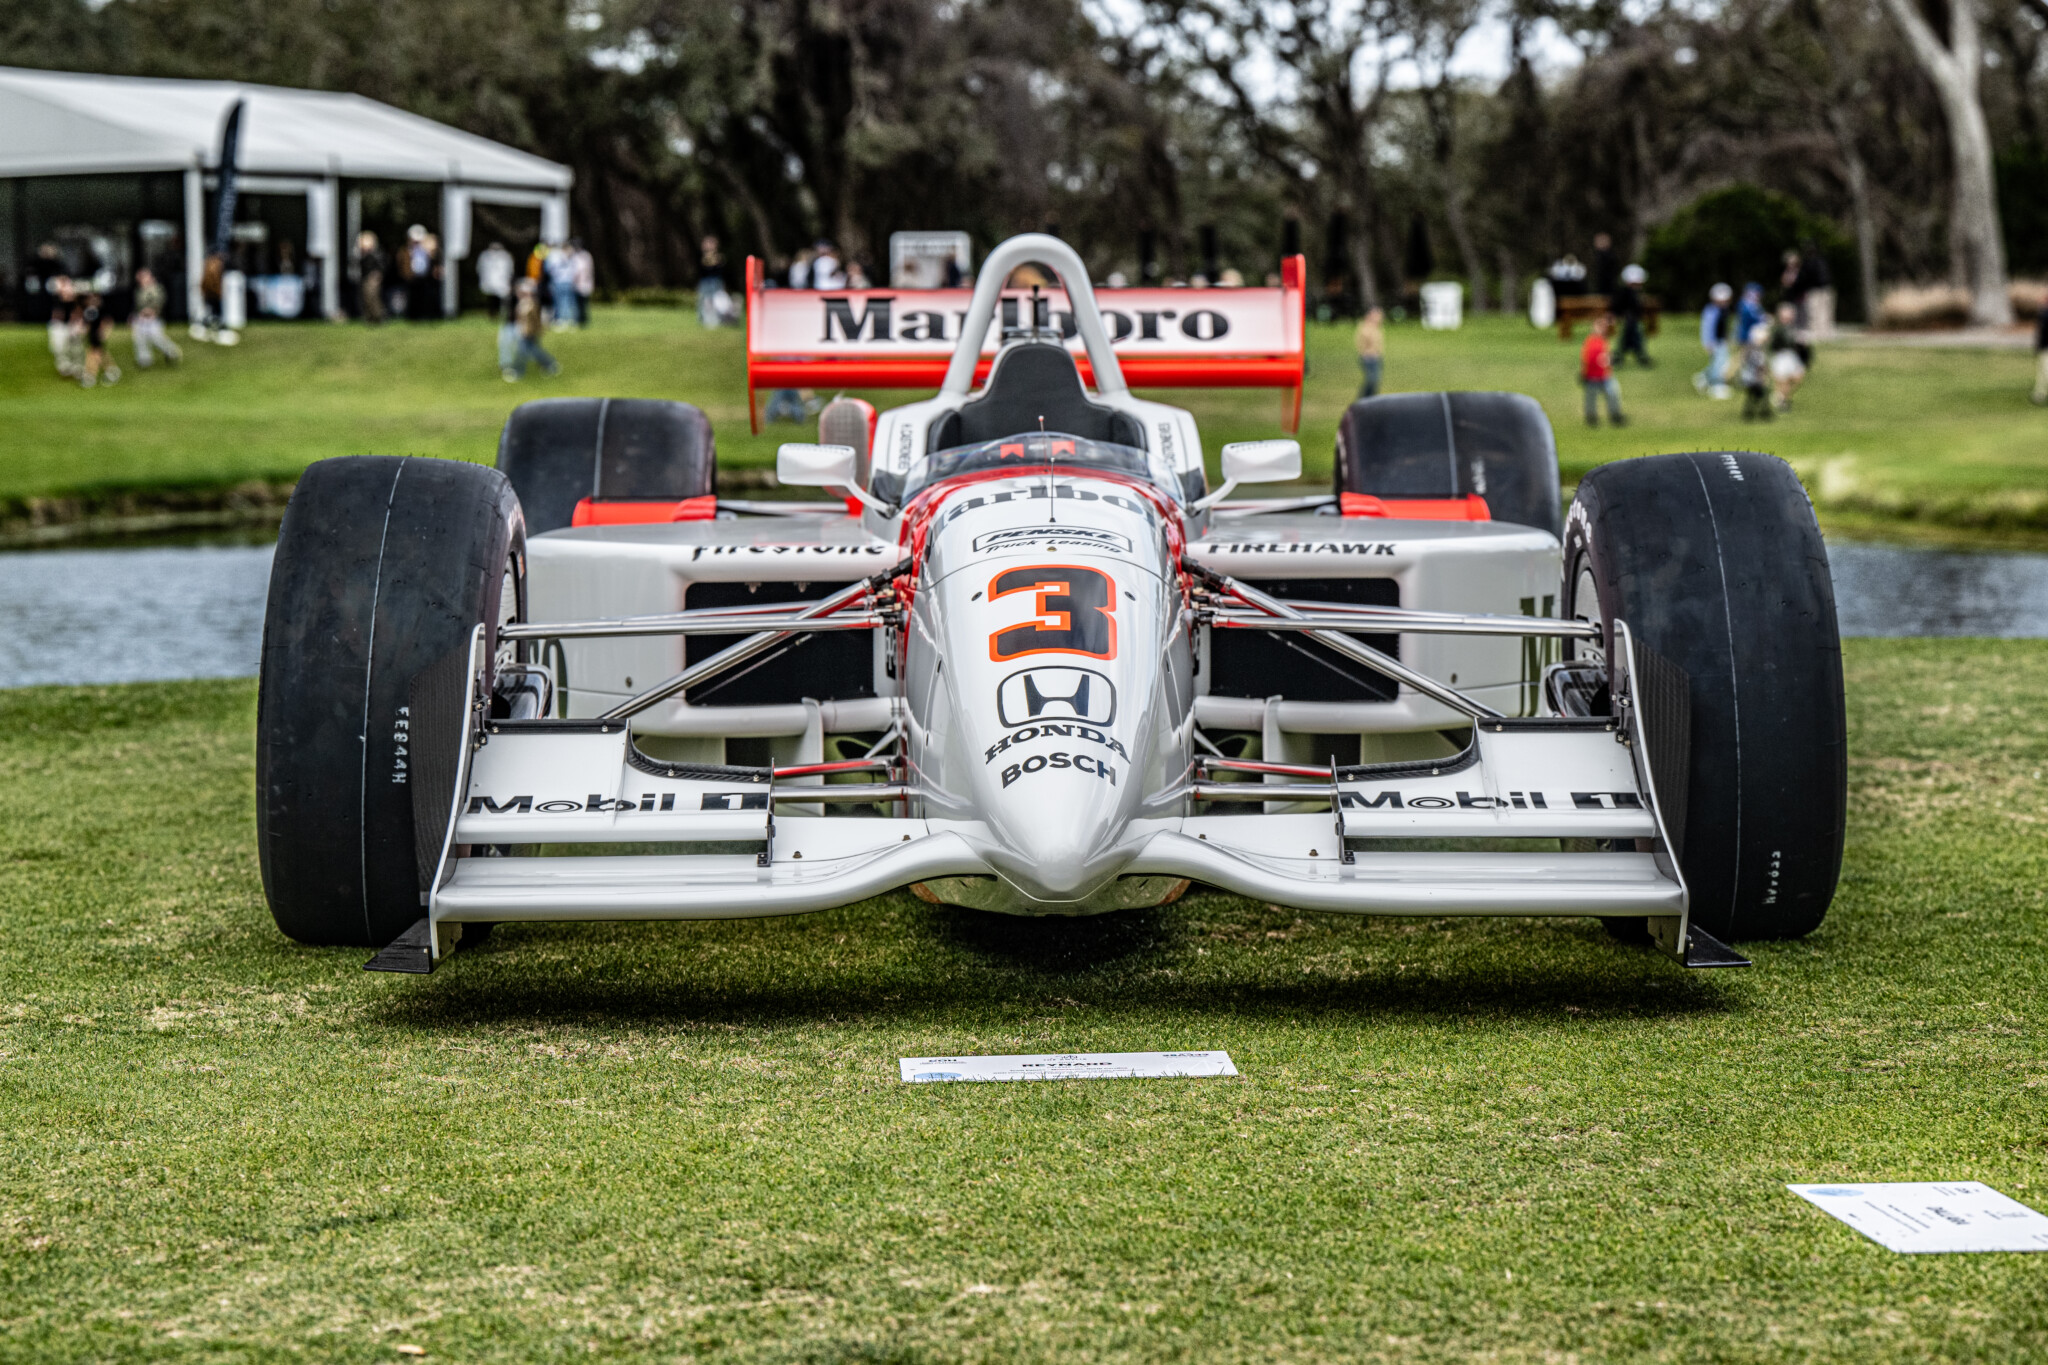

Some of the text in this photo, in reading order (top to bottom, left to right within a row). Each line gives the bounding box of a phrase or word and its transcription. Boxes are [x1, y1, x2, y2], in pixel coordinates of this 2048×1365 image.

[820, 297, 1230, 342] Malboro
[986, 528, 1119, 544] PENSKE
[986, 540, 1122, 554] Truck Leasing
[988, 564, 1118, 662] 3
[984, 724, 1131, 765] HONDA
[1001, 752, 1117, 789] BOSCH
[466, 793, 676, 813] Mobil
[1338, 791, 1549, 809] Mobil
